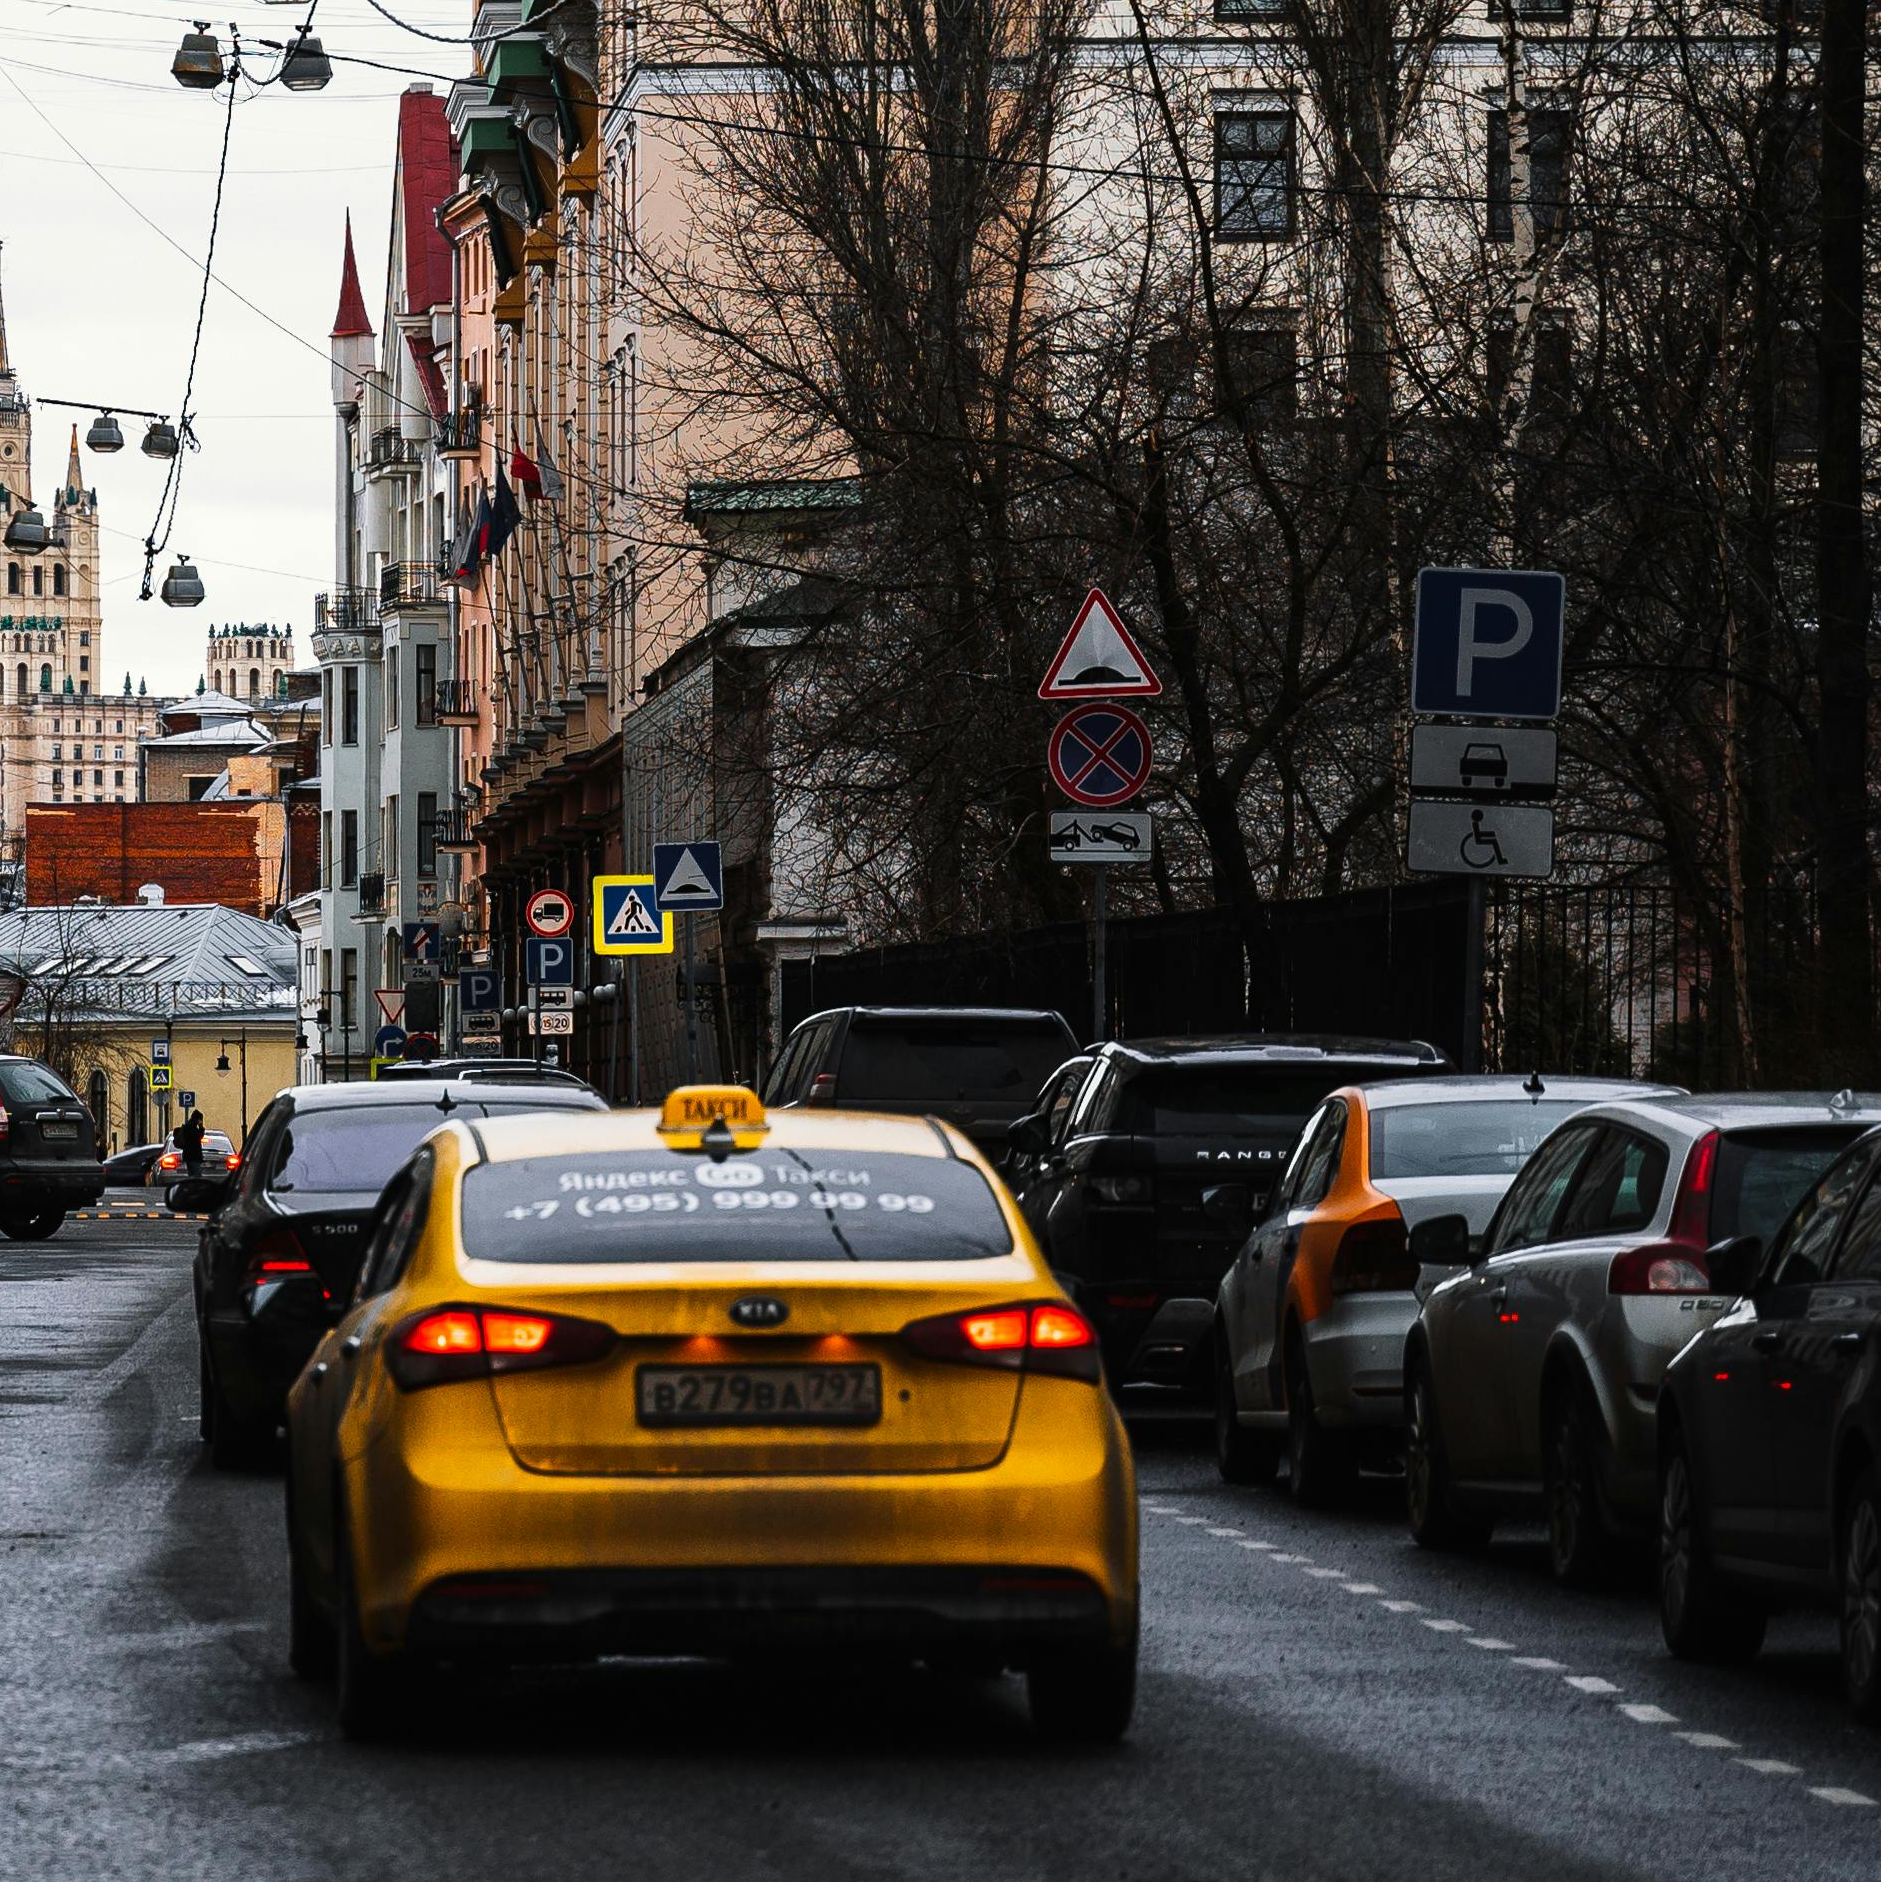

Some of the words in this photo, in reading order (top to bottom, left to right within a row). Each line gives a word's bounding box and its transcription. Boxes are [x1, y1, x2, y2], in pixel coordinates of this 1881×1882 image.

[1456, 587, 1534, 697] P
[540, 943, 564, 979] P
[470, 975, 493, 1007] P
[542, 1019, 552, 1028] 15
[554, 1017, 568, 1029] 20
[183, 1093, 192, 1105] P
[683, 1097, 748, 1121] ТАКСИ
[558, 1168, 690, 1193] Яндекс
[774, 1164, 871, 1186] Такси
[504, 1199, 560, 1221] +7
[574, 1192, 700, 1218] (495)
[712, 1190, 800, 1212] 999
[810, 1191, 868, 1211] 99
[877, 1192, 936, 1214] 99
[739, 1302, 779, 1318] KIA
